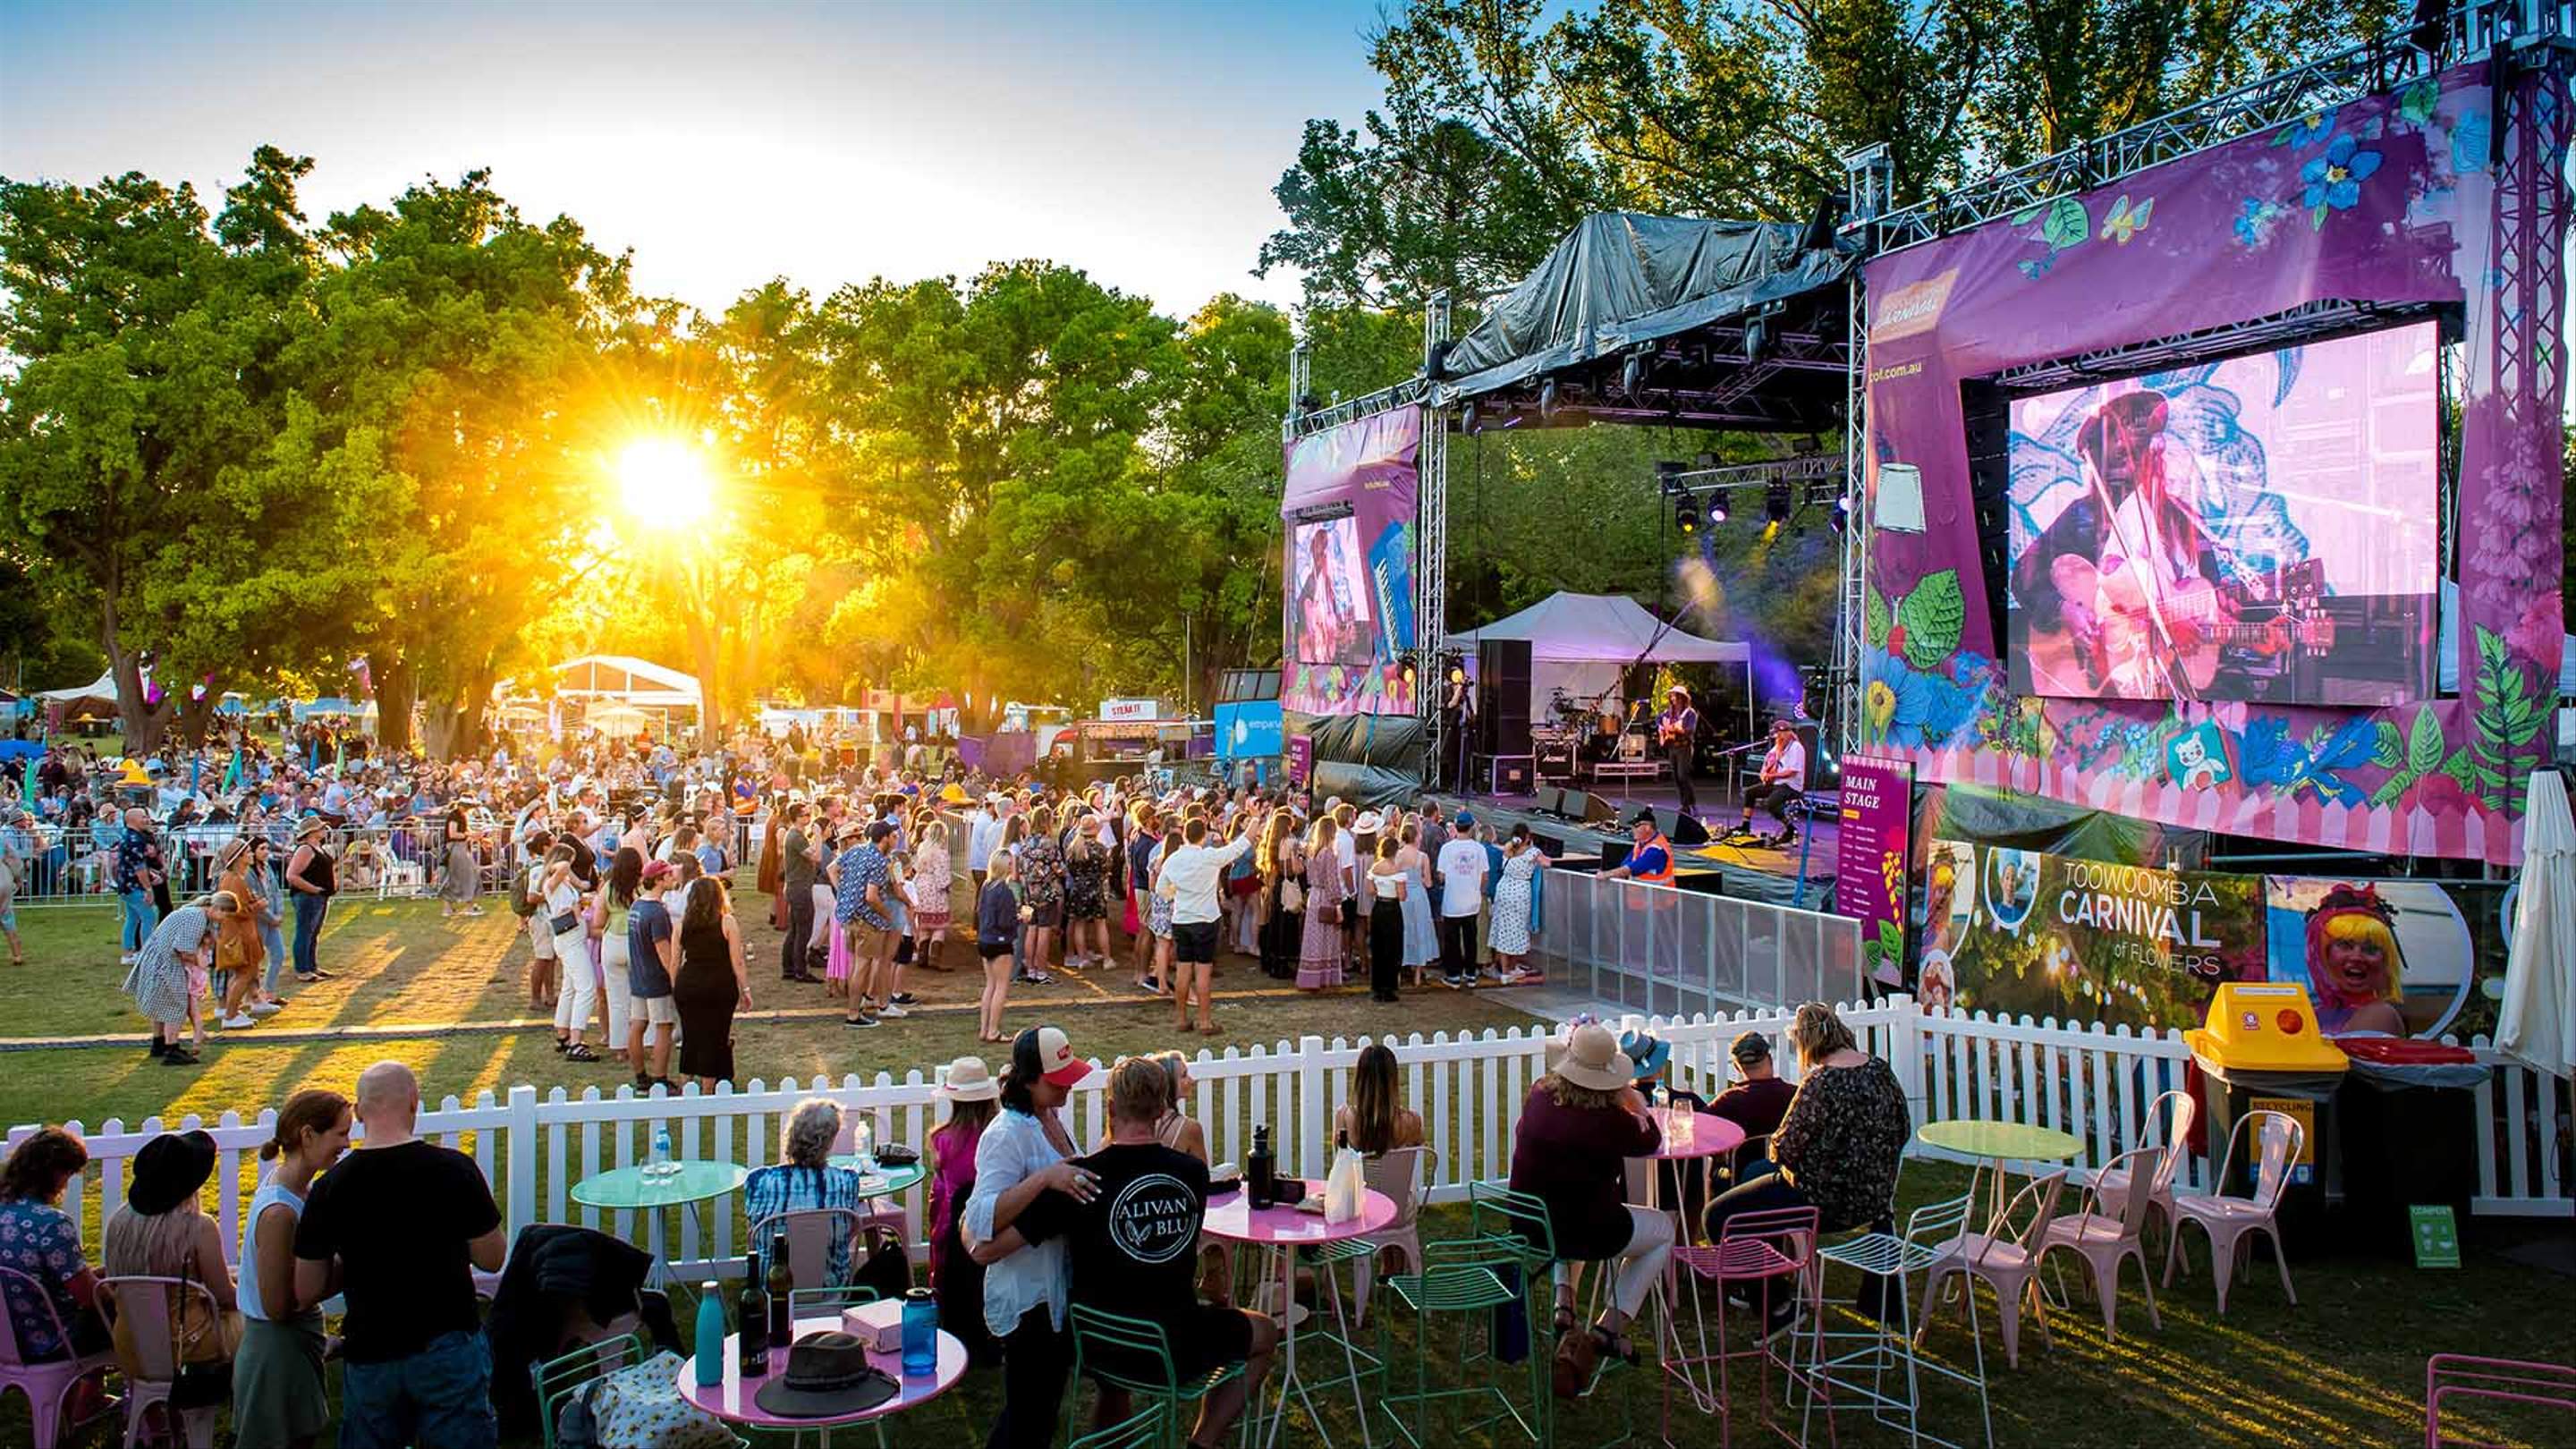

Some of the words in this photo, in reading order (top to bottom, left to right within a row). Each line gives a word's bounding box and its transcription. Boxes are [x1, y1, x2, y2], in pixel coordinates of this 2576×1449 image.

[1845, 775, 1878, 792] MAIN
[1844, 792, 1880, 809] STAGE
[2063, 862, 2220, 907] TOOWOOMBA
[2059, 890, 2223, 948] CARNIVAL
[2131, 945, 2221, 977] FLOWERS
[1118, 1198, 1187, 1219] ALIVAN
[1156, 1217, 1189, 1236] BLU
